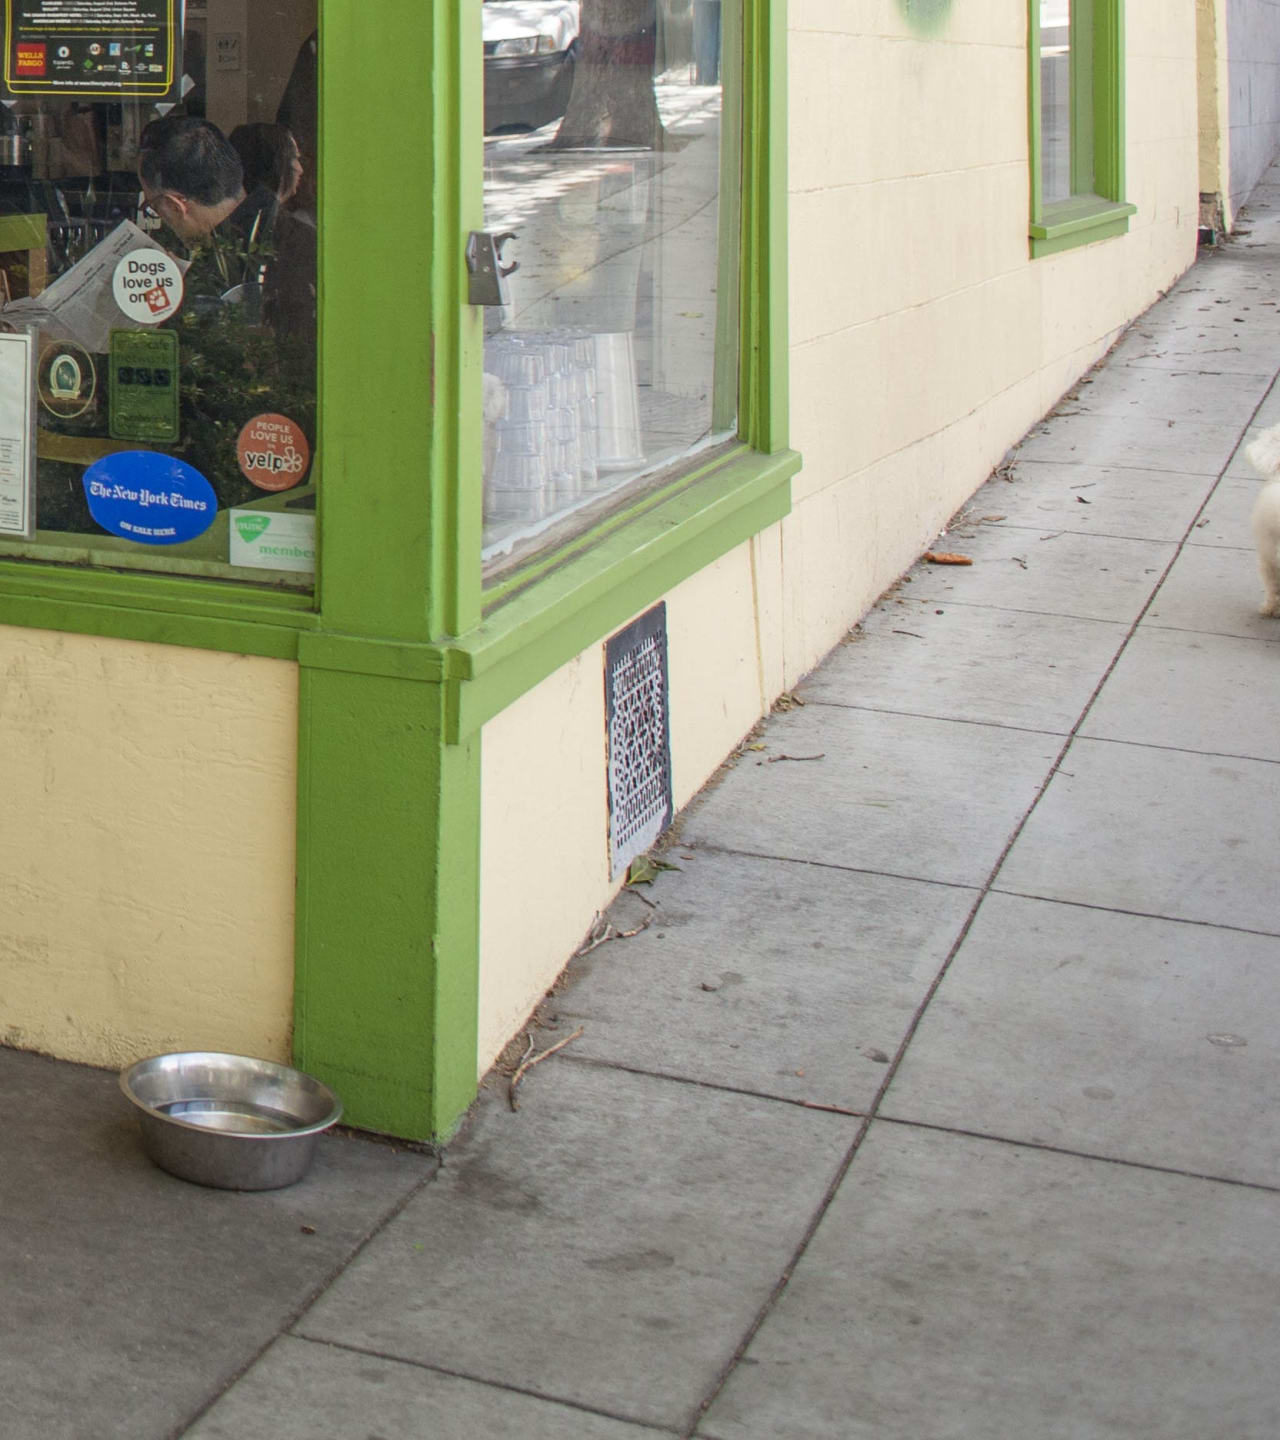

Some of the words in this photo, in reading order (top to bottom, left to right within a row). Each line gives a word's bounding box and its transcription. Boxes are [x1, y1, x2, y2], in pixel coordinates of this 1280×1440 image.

[128, 261, 166, 276] Dogs
[123, 276, 152, 289] love
[156, 277, 173, 288] us
[129, 294, 147, 303] on
[257, 422, 290, 433] PEOPLE
[251, 431, 278, 442] LOVE
[280, 435, 293, 444] US
[246, 452, 283, 473] yelp
[90, 481, 112, 499] The
[112, 484, 138, 501] New
[139, 488, 168, 507] York
[170, 492, 207, 511] Times
